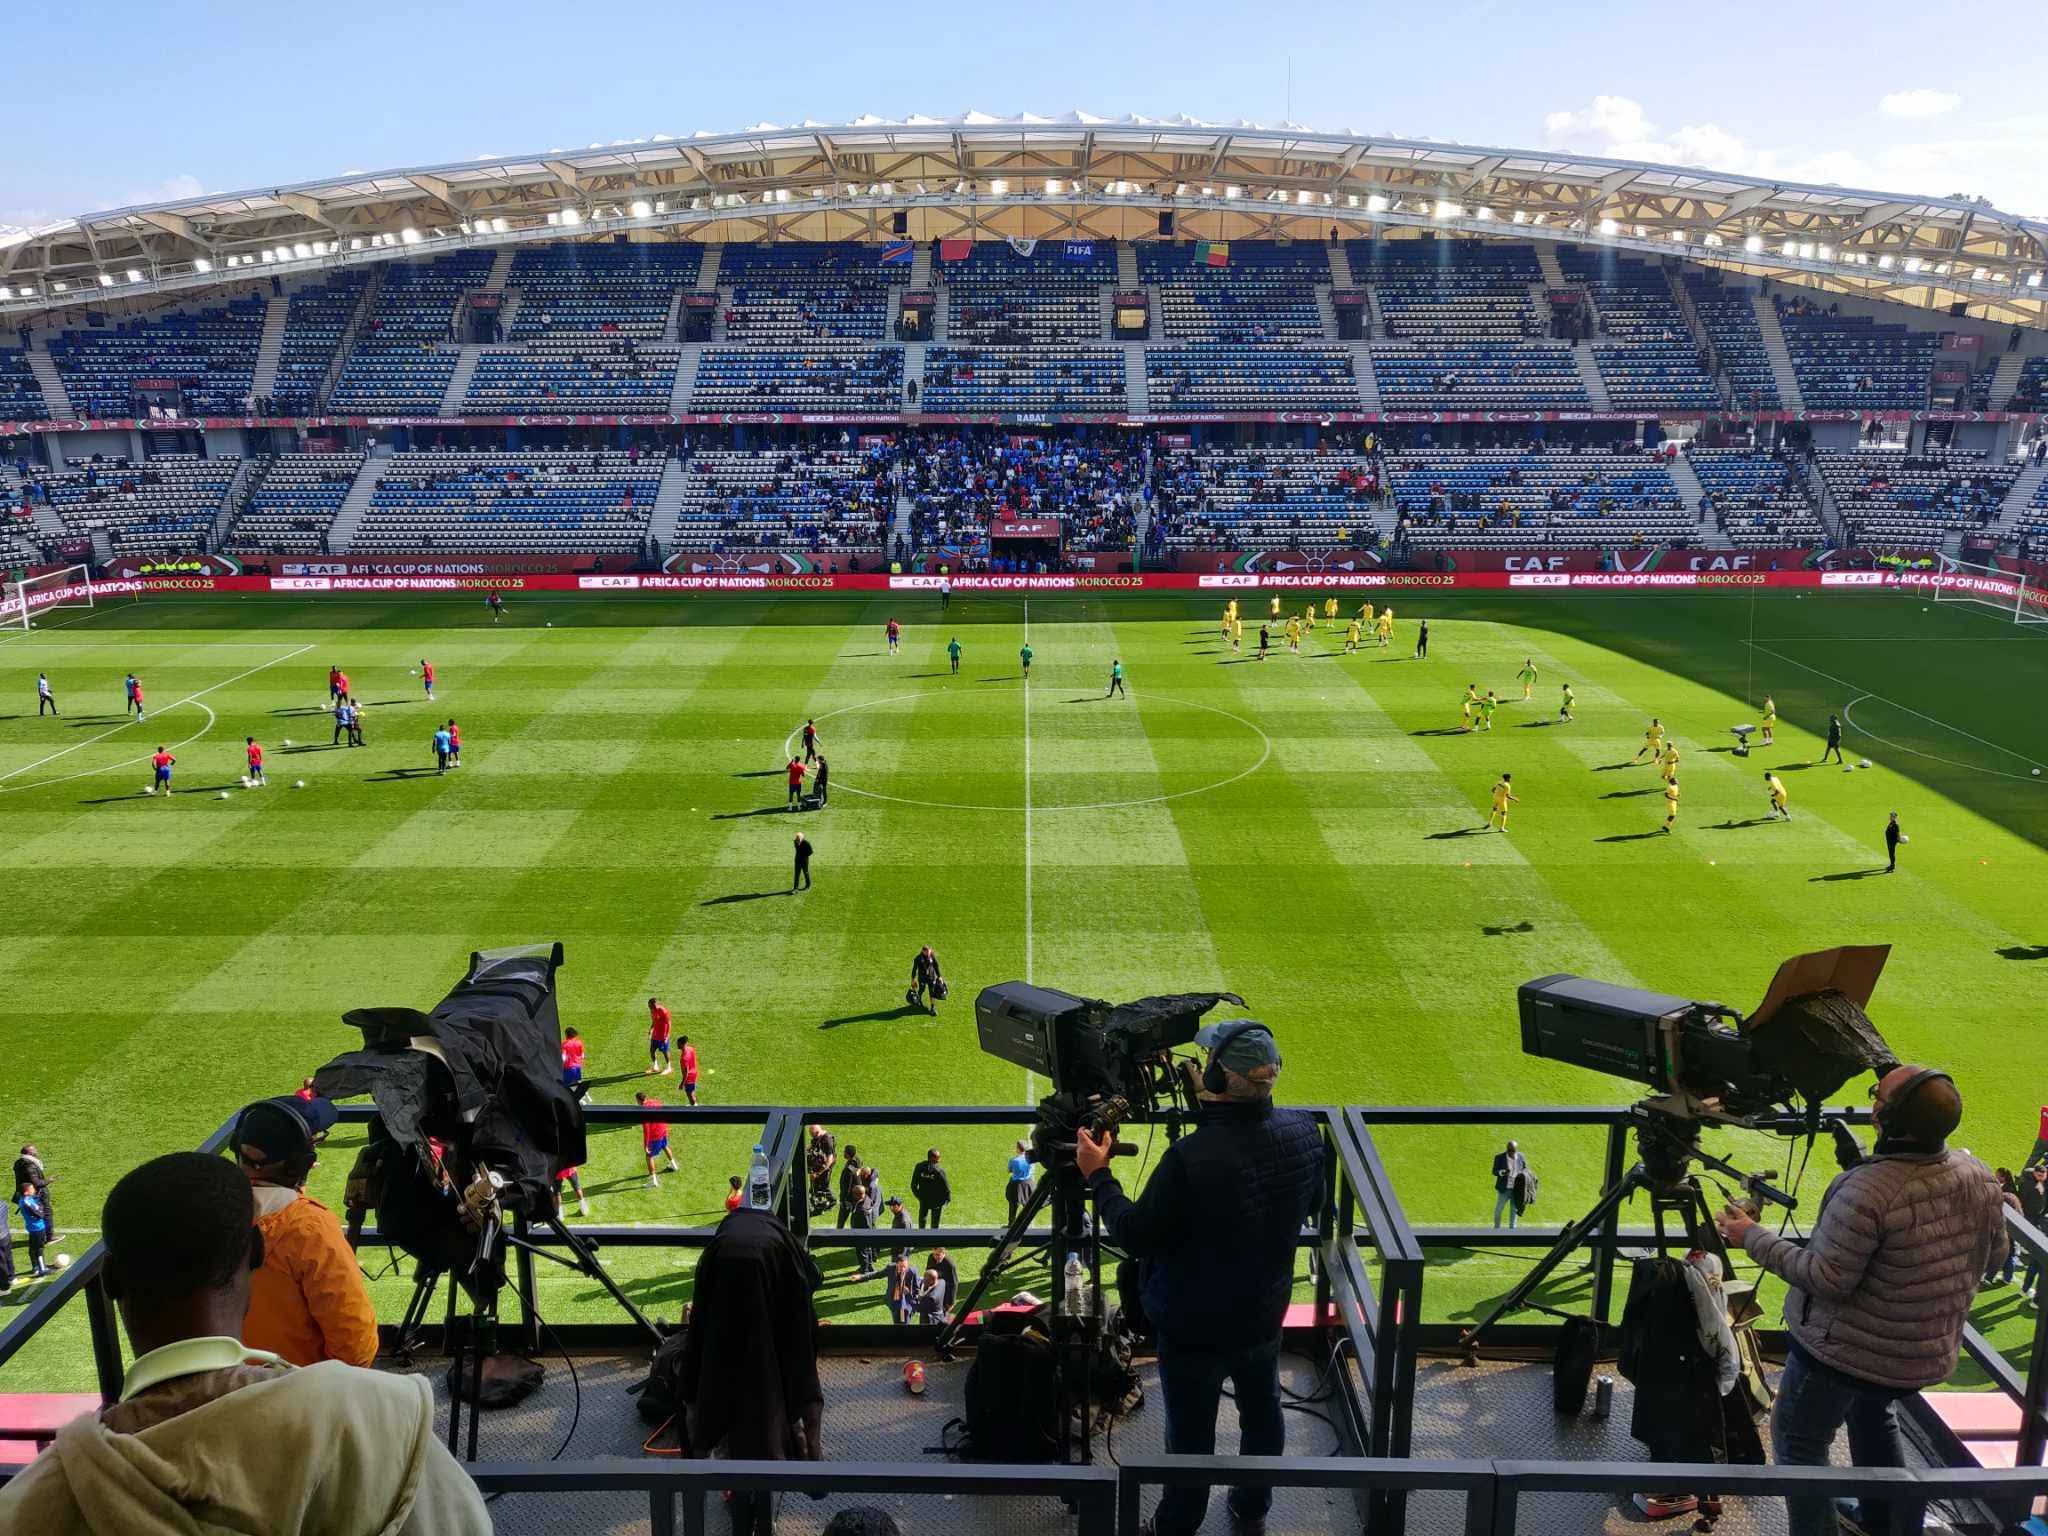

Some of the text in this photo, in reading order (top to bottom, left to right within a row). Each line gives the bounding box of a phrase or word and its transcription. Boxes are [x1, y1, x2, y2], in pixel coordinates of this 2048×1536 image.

[1067, 245, 1091, 256] FIFA
[1016, 413, 1046, 422] RABAT
[1005, 524, 1043, 532] CAF
[1505, 557, 1564, 571] CAF
[1690, 556, 1750, 570] CAF
[308, 565, 341, 574] CAF
[352, 565, 392, 574] AFCA
[393, 565, 415, 574] CUP
[417, 565, 433, 574] OF
[435, 564, 484, 574] NATIONS
[333, 578, 524, 588] AFRICA CUP OF NATIONS MOROCCO 25
[641, 577, 833, 587] AFRICA CUP OF NATIONS MOROCCO 25
[912, 578, 942, 586] CAF
[952, 577, 1143, 587] AFRICA CUP OF NATIONS MOROCCO 25
[1221, 577, 1251, 585] CAF
[1262, 575, 1455, 586] AFRICA CUP OF NATIONS MOROCCO 25
[1572, 574, 1765, 585] AFRICA CUP OF NATIONS MOROCCO 25
[1845, 575, 1877, 583] CAF
[1931, 576, 1955, 586] CUP
[1956, 578, 1973, 588] OF
[1974, 580, 2013, 595] NATIONS
[28, 579, 214, 606] AFRICA CUP OF NATIONS MOROCCO 25
